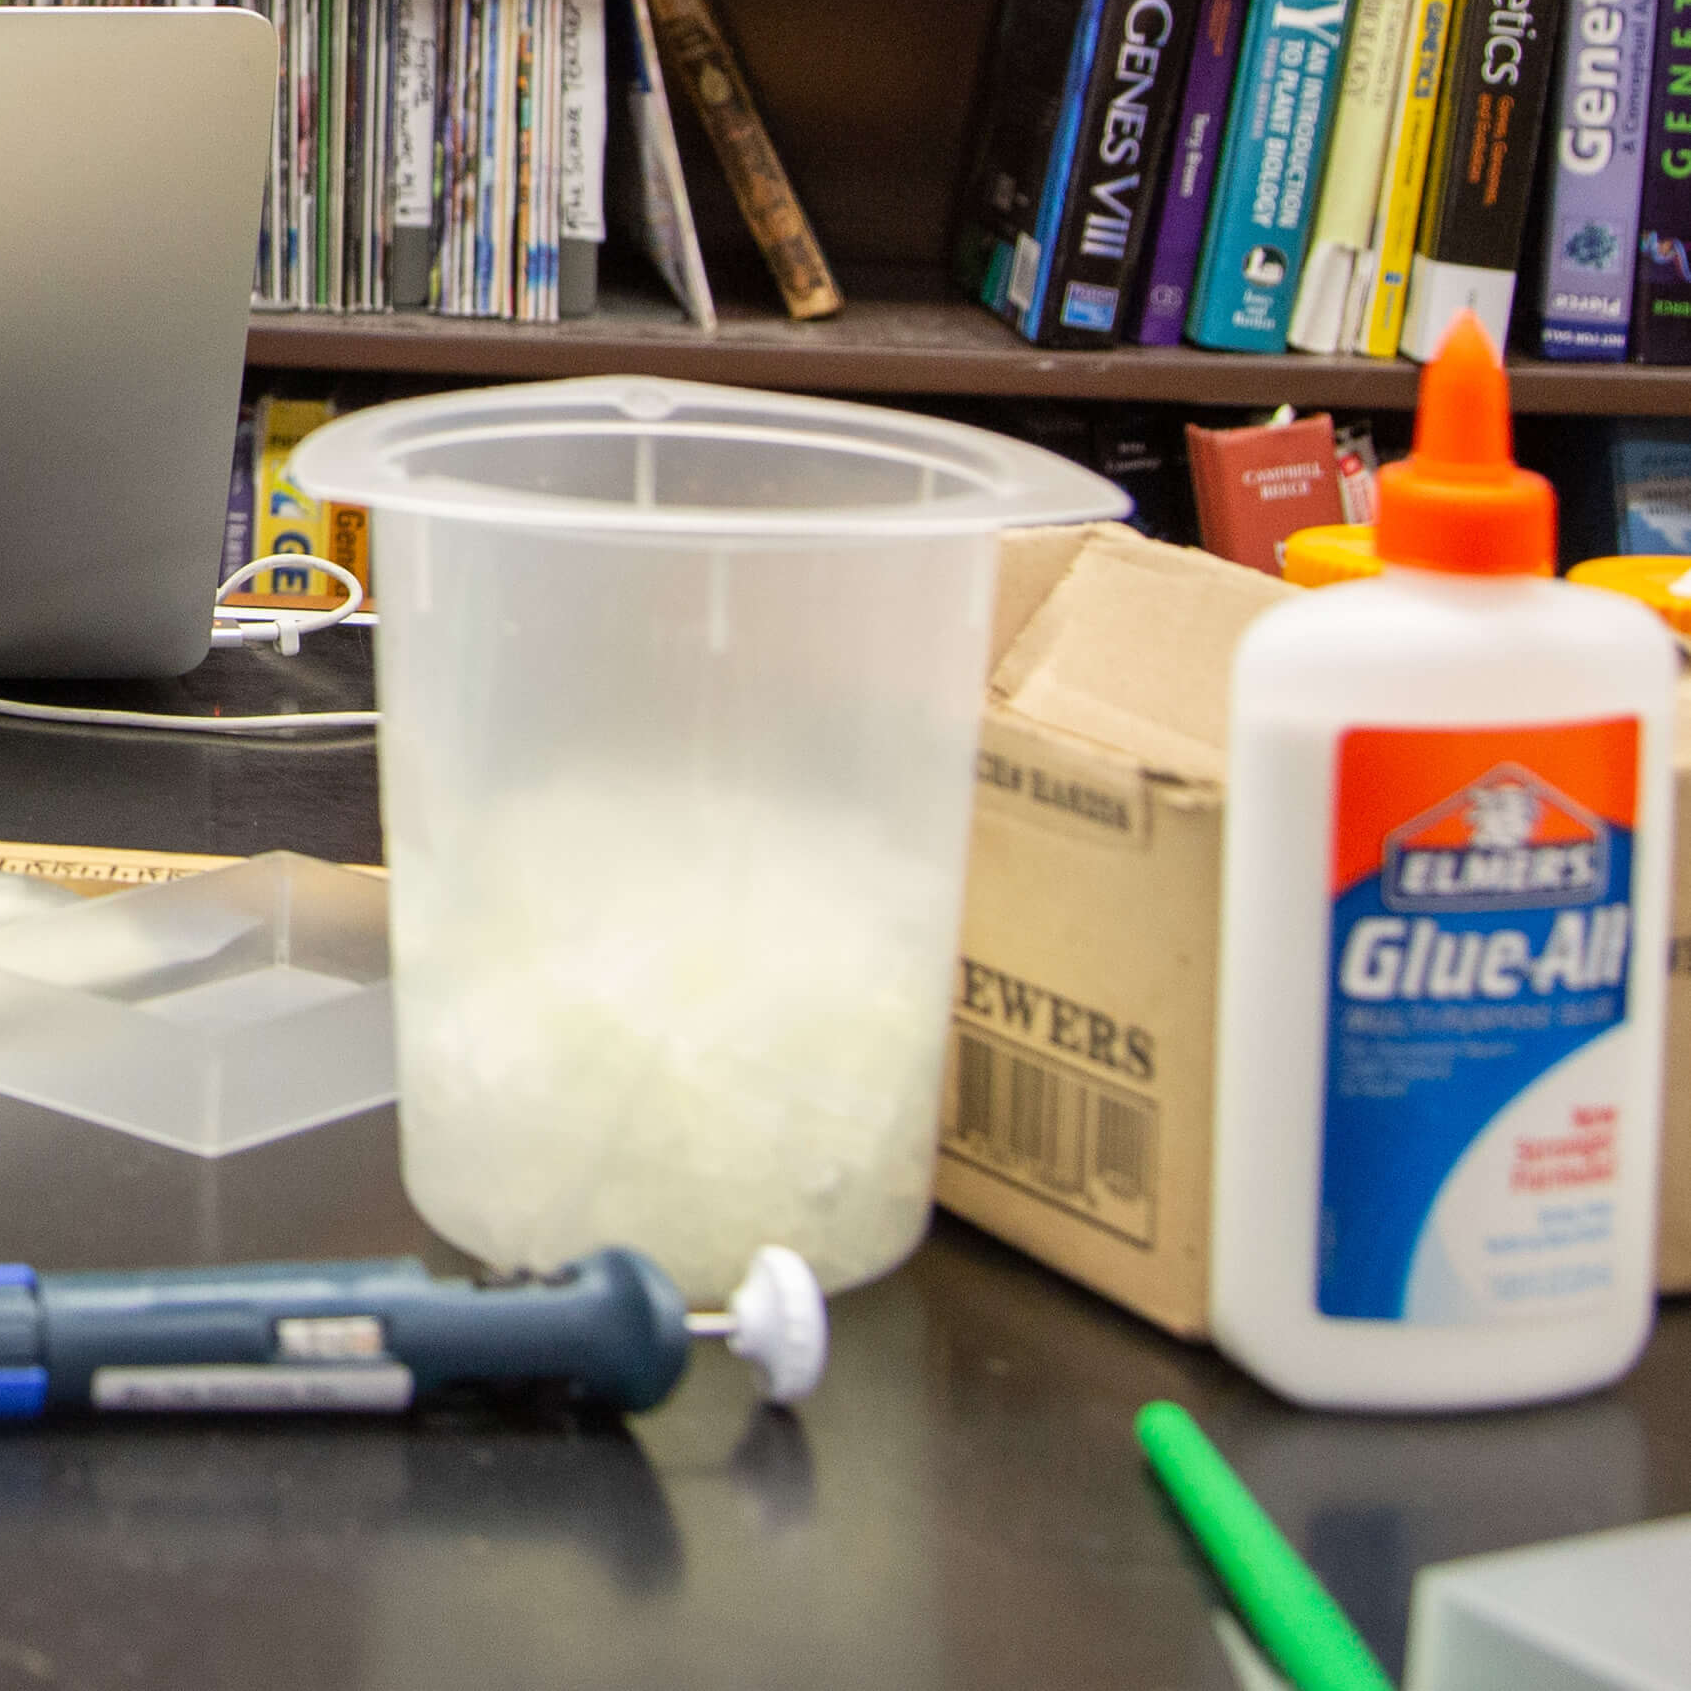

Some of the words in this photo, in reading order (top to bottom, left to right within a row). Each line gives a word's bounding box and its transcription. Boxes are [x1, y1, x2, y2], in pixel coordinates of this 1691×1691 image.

[1280, 39, 1306, 68] TO
[1305, 41, 1330, 75] AN
[1414, 1, 1448, 99] GENETICS
[1269, 68, 1299, 136] PLANT
[1252, 136, 1287, 229] BIOLOGY
[1278, 76, 1324, 230] INTRODUCTION
[1080, 172, 1142, 259] VIII
[1339, 901, 1630, 1001] Glue-All
